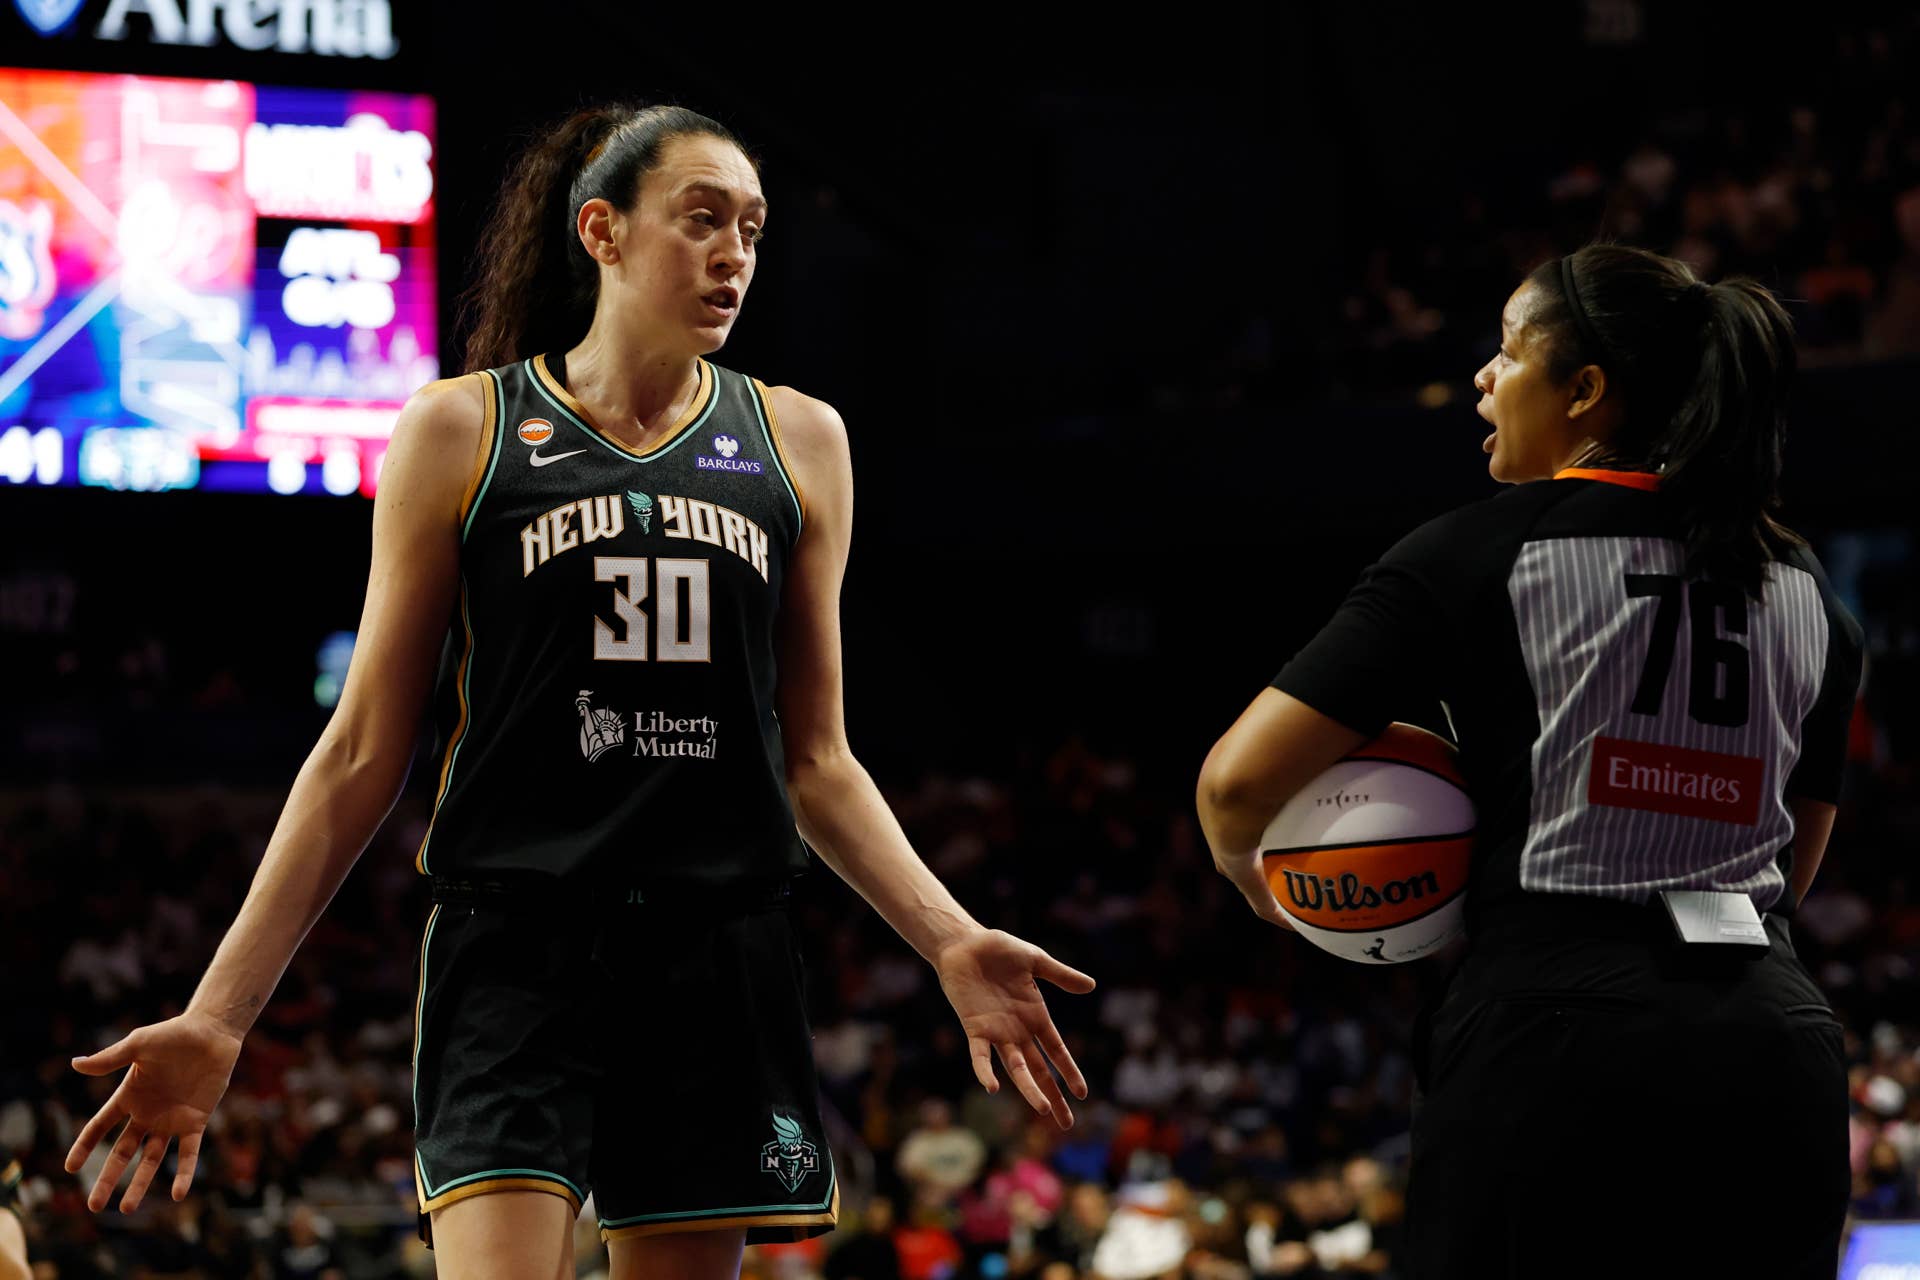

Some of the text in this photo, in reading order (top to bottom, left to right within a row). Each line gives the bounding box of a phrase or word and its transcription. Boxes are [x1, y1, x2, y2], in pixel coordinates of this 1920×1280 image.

[698, 456, 761, 473] BARCLAYS
[520, 494, 769, 585] NEW YORK
[593, 556, 712, 664] 30
[1624, 574, 1750, 727] 76
[632, 736, 717, 760] Mutual
[634, 711, 719, 743] Liberty
[1607, 755, 1742, 804] Emirates
[1282, 868, 1440, 913] Wilson
